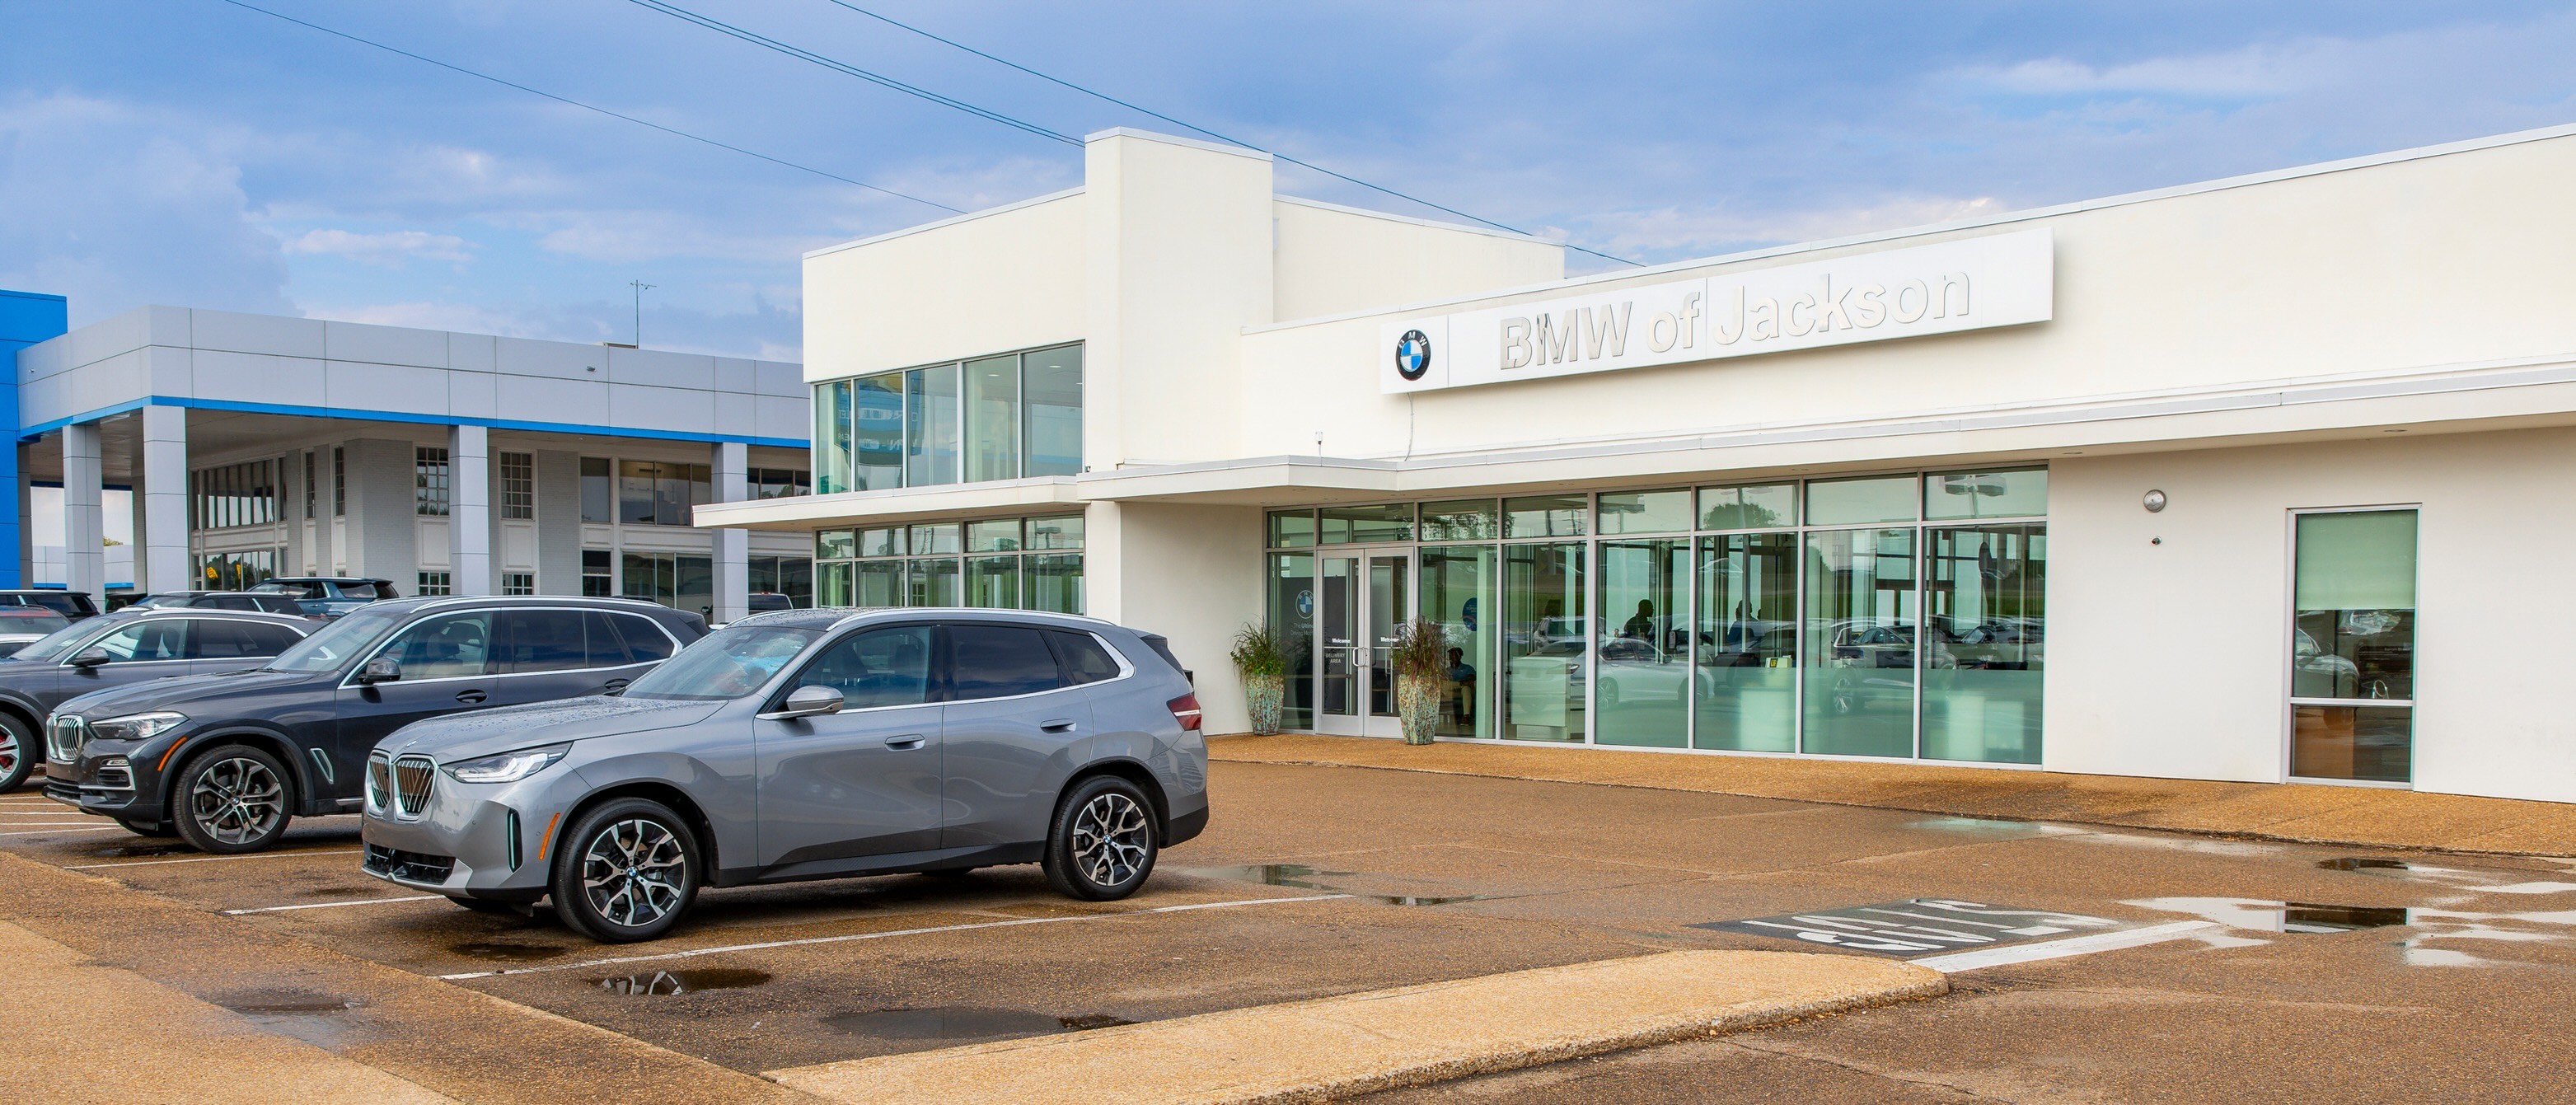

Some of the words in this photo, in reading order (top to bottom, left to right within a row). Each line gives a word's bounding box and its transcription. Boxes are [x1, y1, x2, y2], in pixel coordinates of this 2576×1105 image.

[1398, 331, 1427, 349] BMW
[1500, 302, 1632, 370] BMW
[1647, 292, 1701, 354] of
[1713, 272, 1970, 346] Jackson
